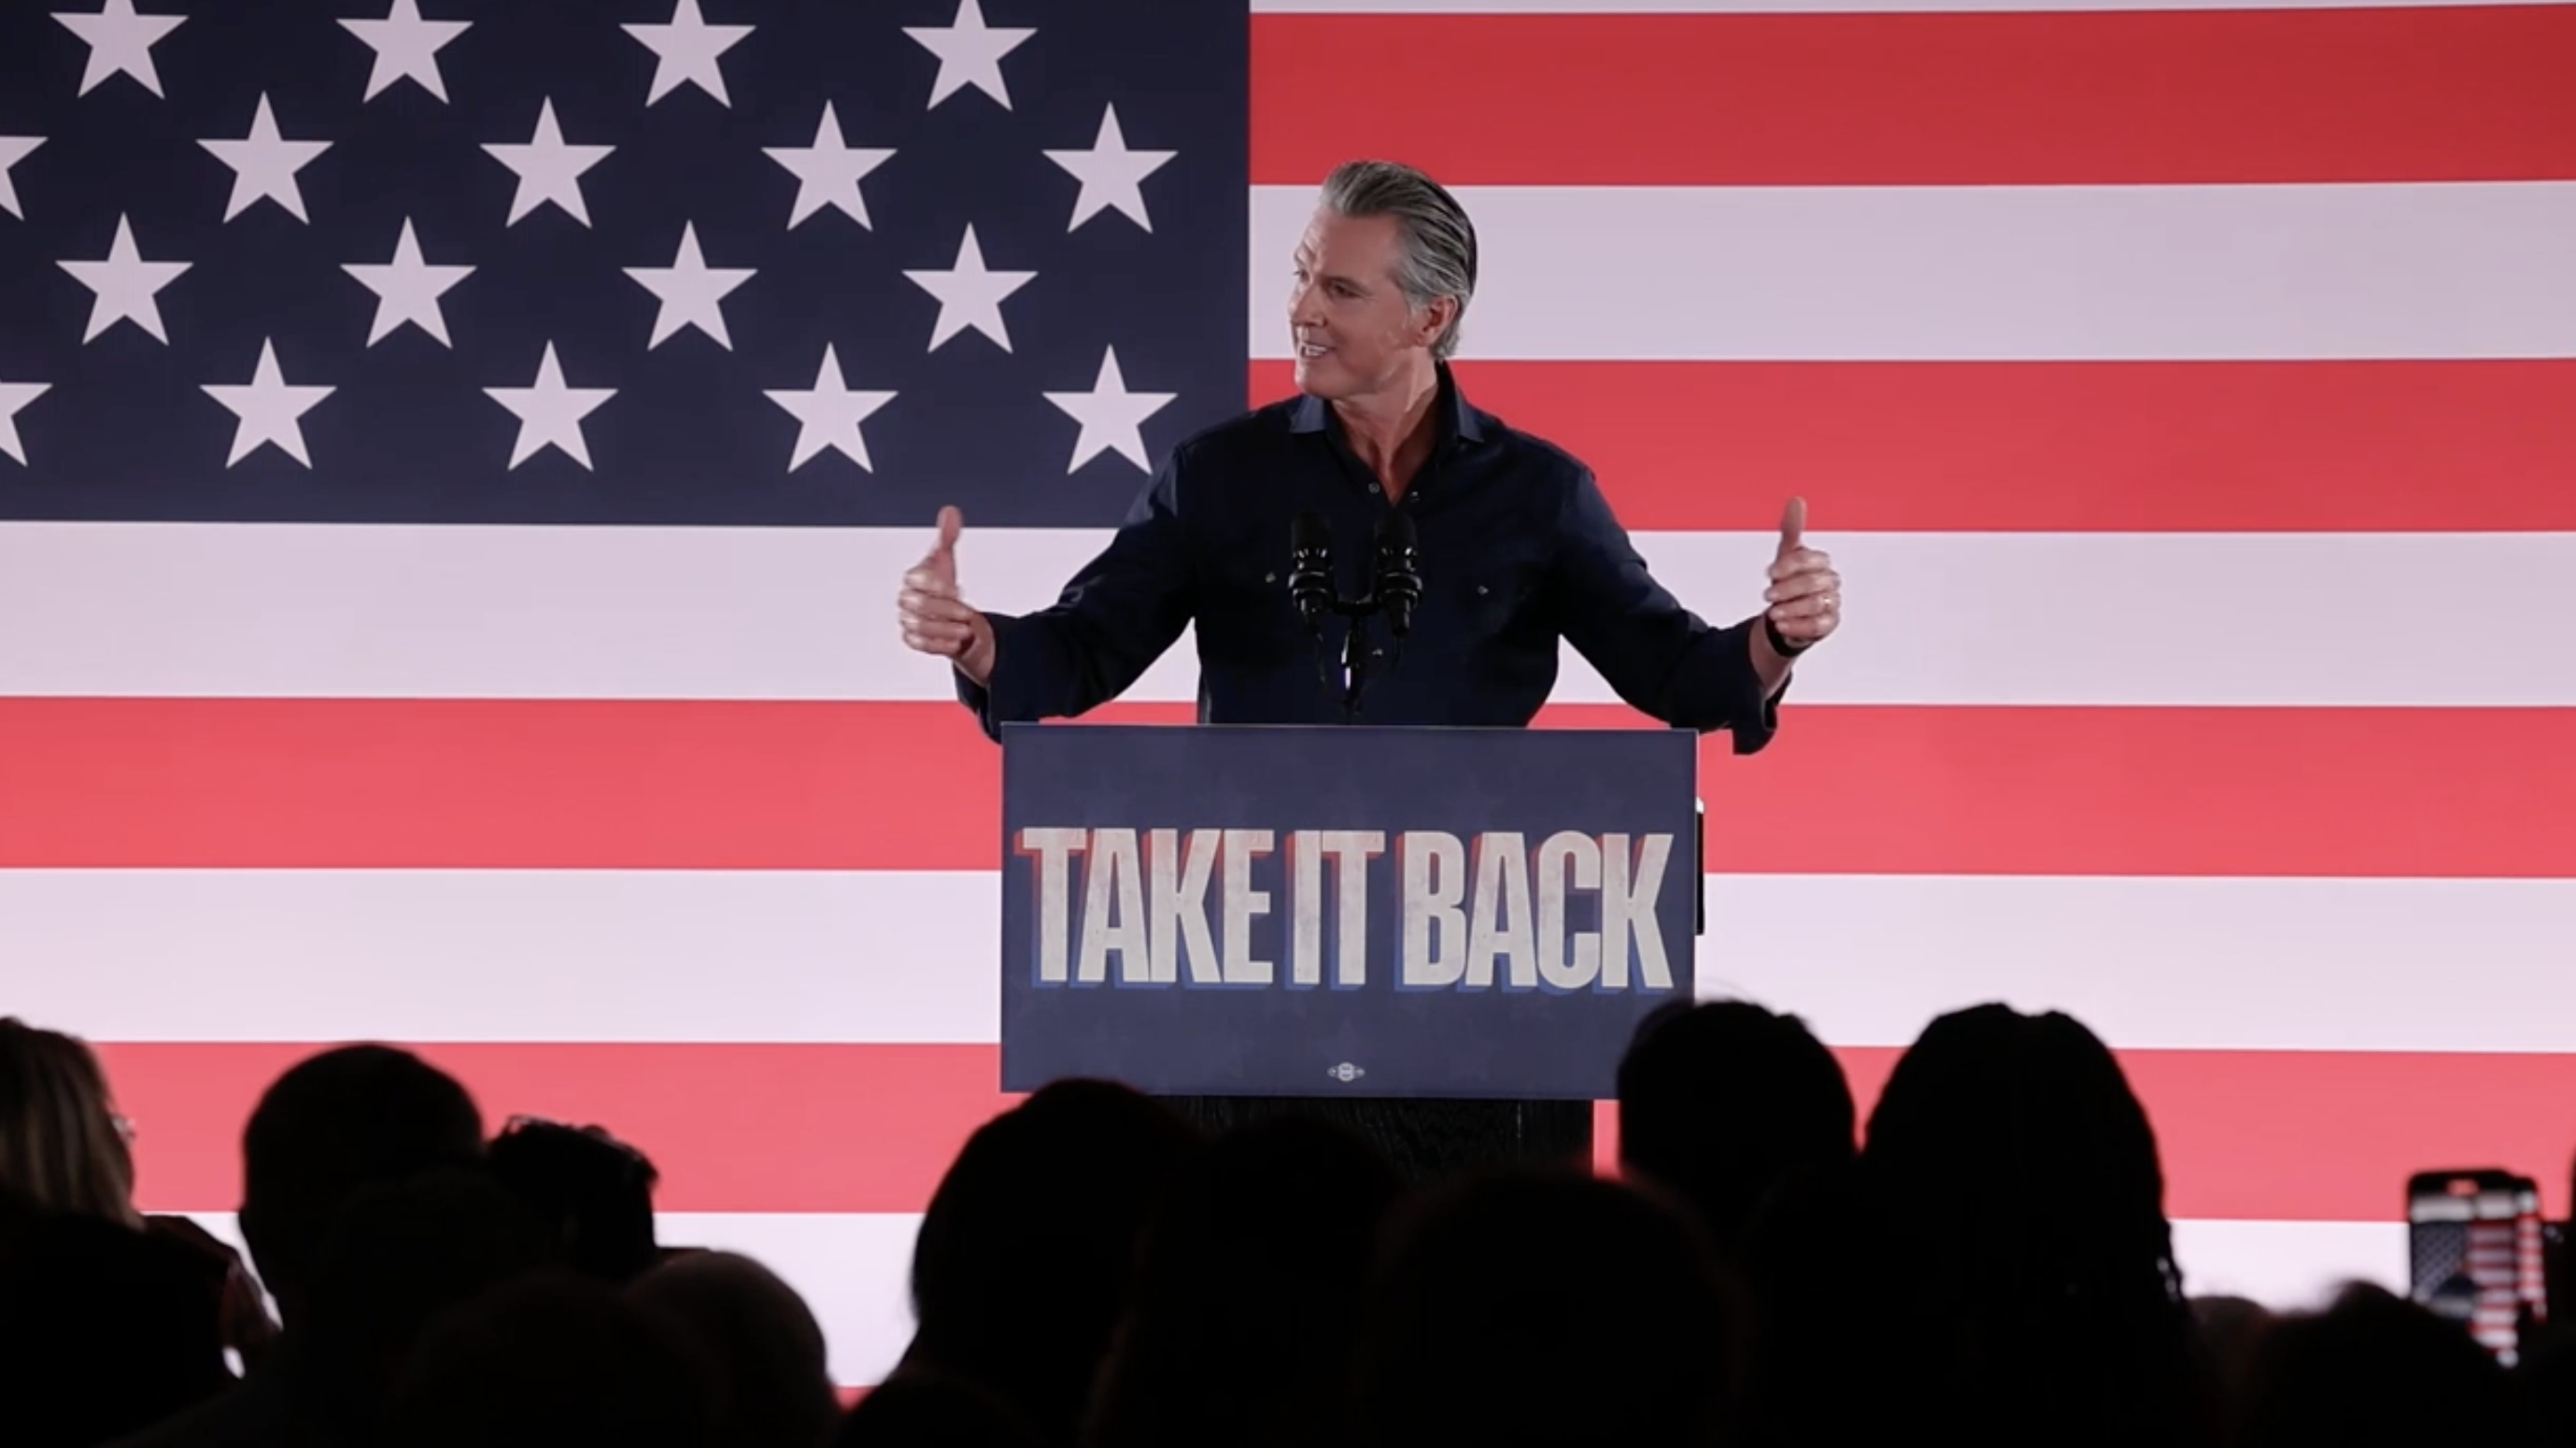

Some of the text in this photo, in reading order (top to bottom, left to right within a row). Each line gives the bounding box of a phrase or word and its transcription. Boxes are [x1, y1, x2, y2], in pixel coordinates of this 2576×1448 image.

[1019, 827, 1675, 990] TAKE IT BACK
